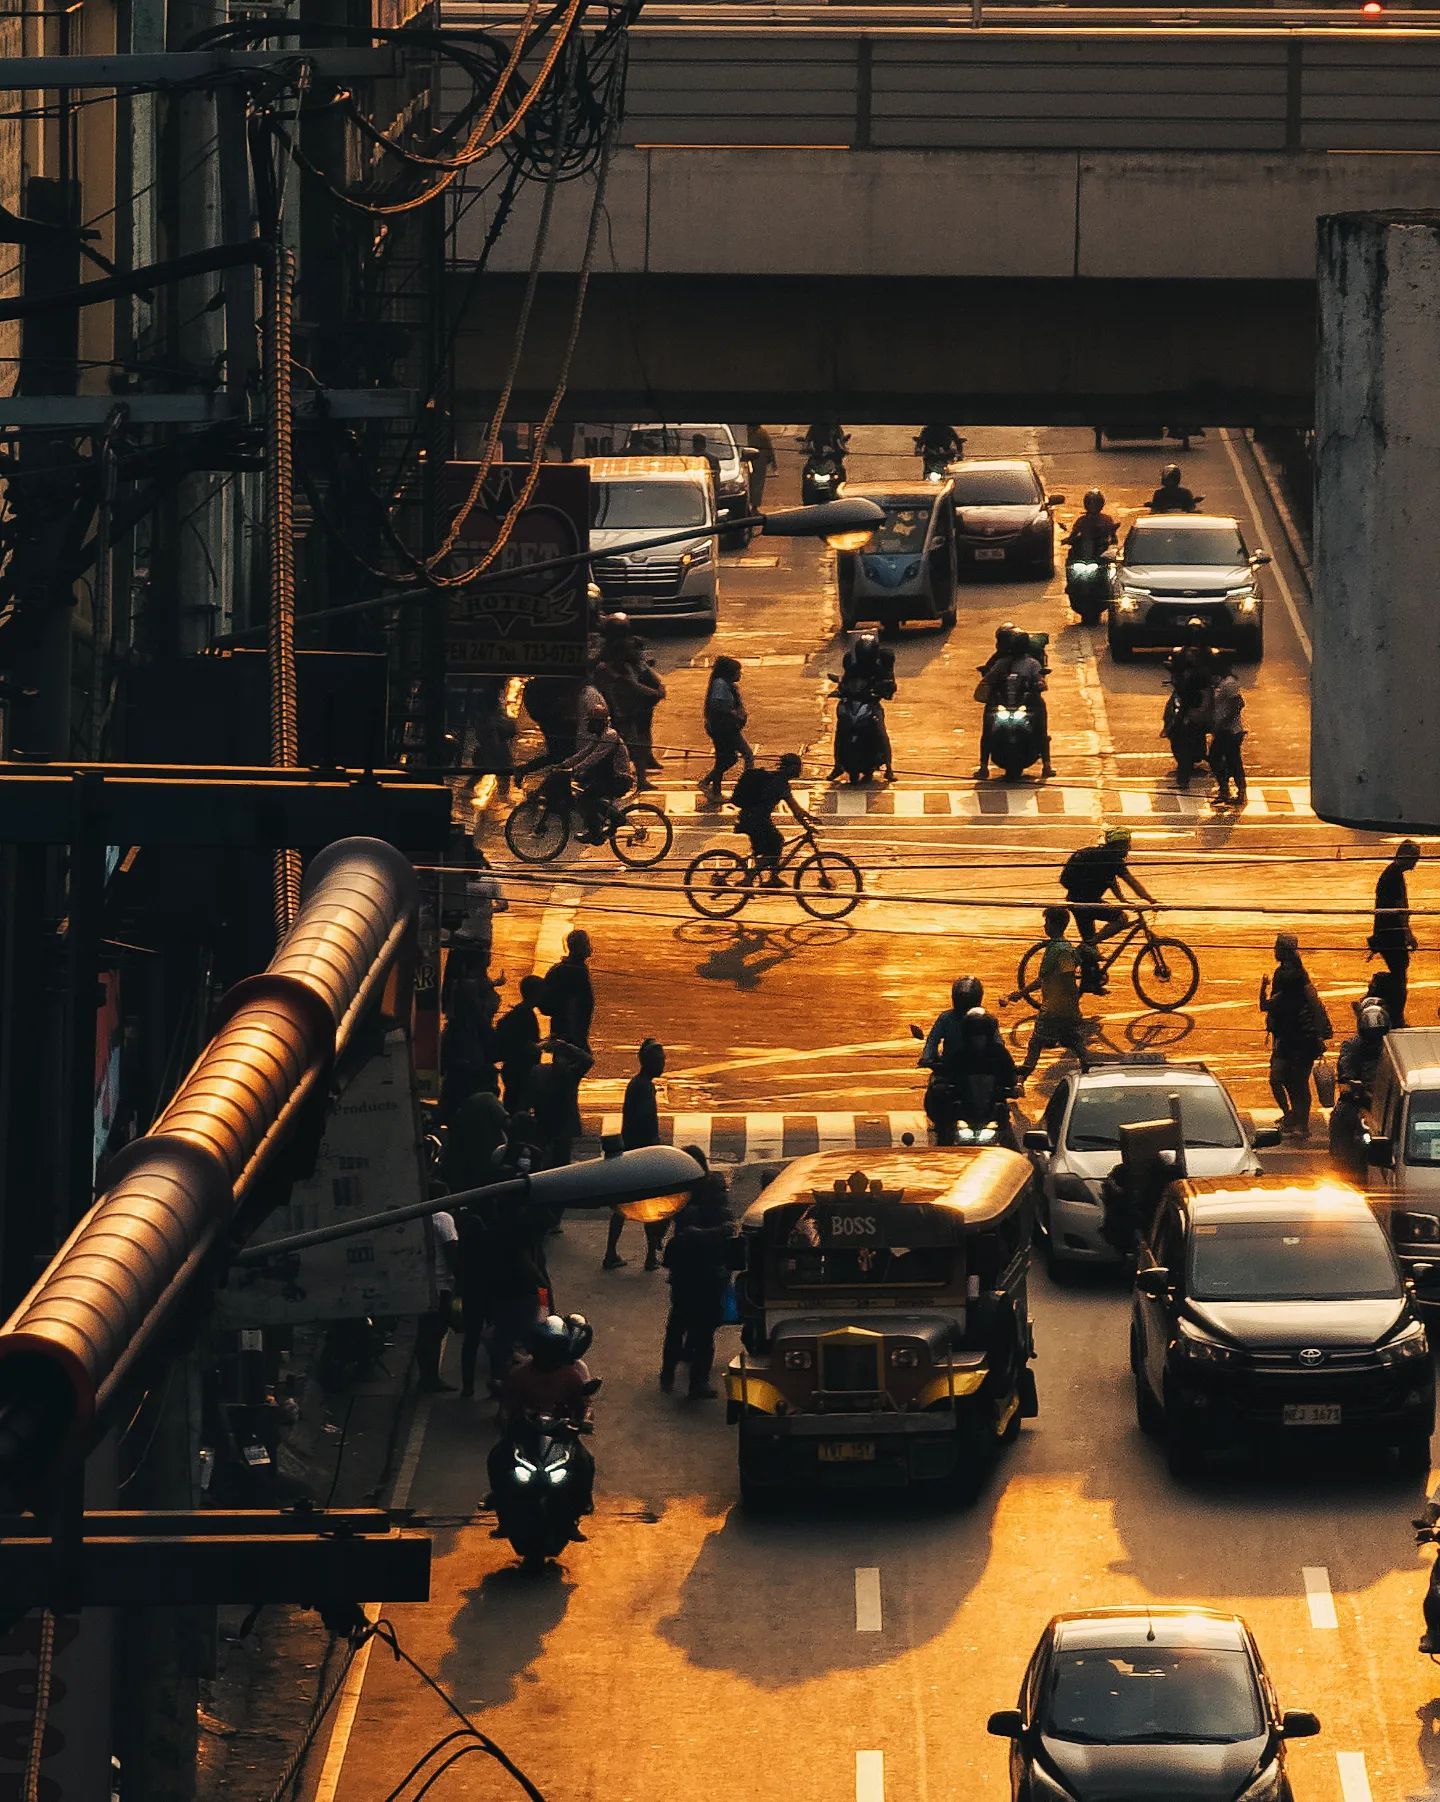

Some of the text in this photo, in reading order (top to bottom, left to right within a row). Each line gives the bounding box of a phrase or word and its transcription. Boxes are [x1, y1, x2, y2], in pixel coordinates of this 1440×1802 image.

[465, 595, 547, 613] HOTEL
[335, 1100, 399, 1116] Products
[831, 1216, 877, 1236] BOSS
